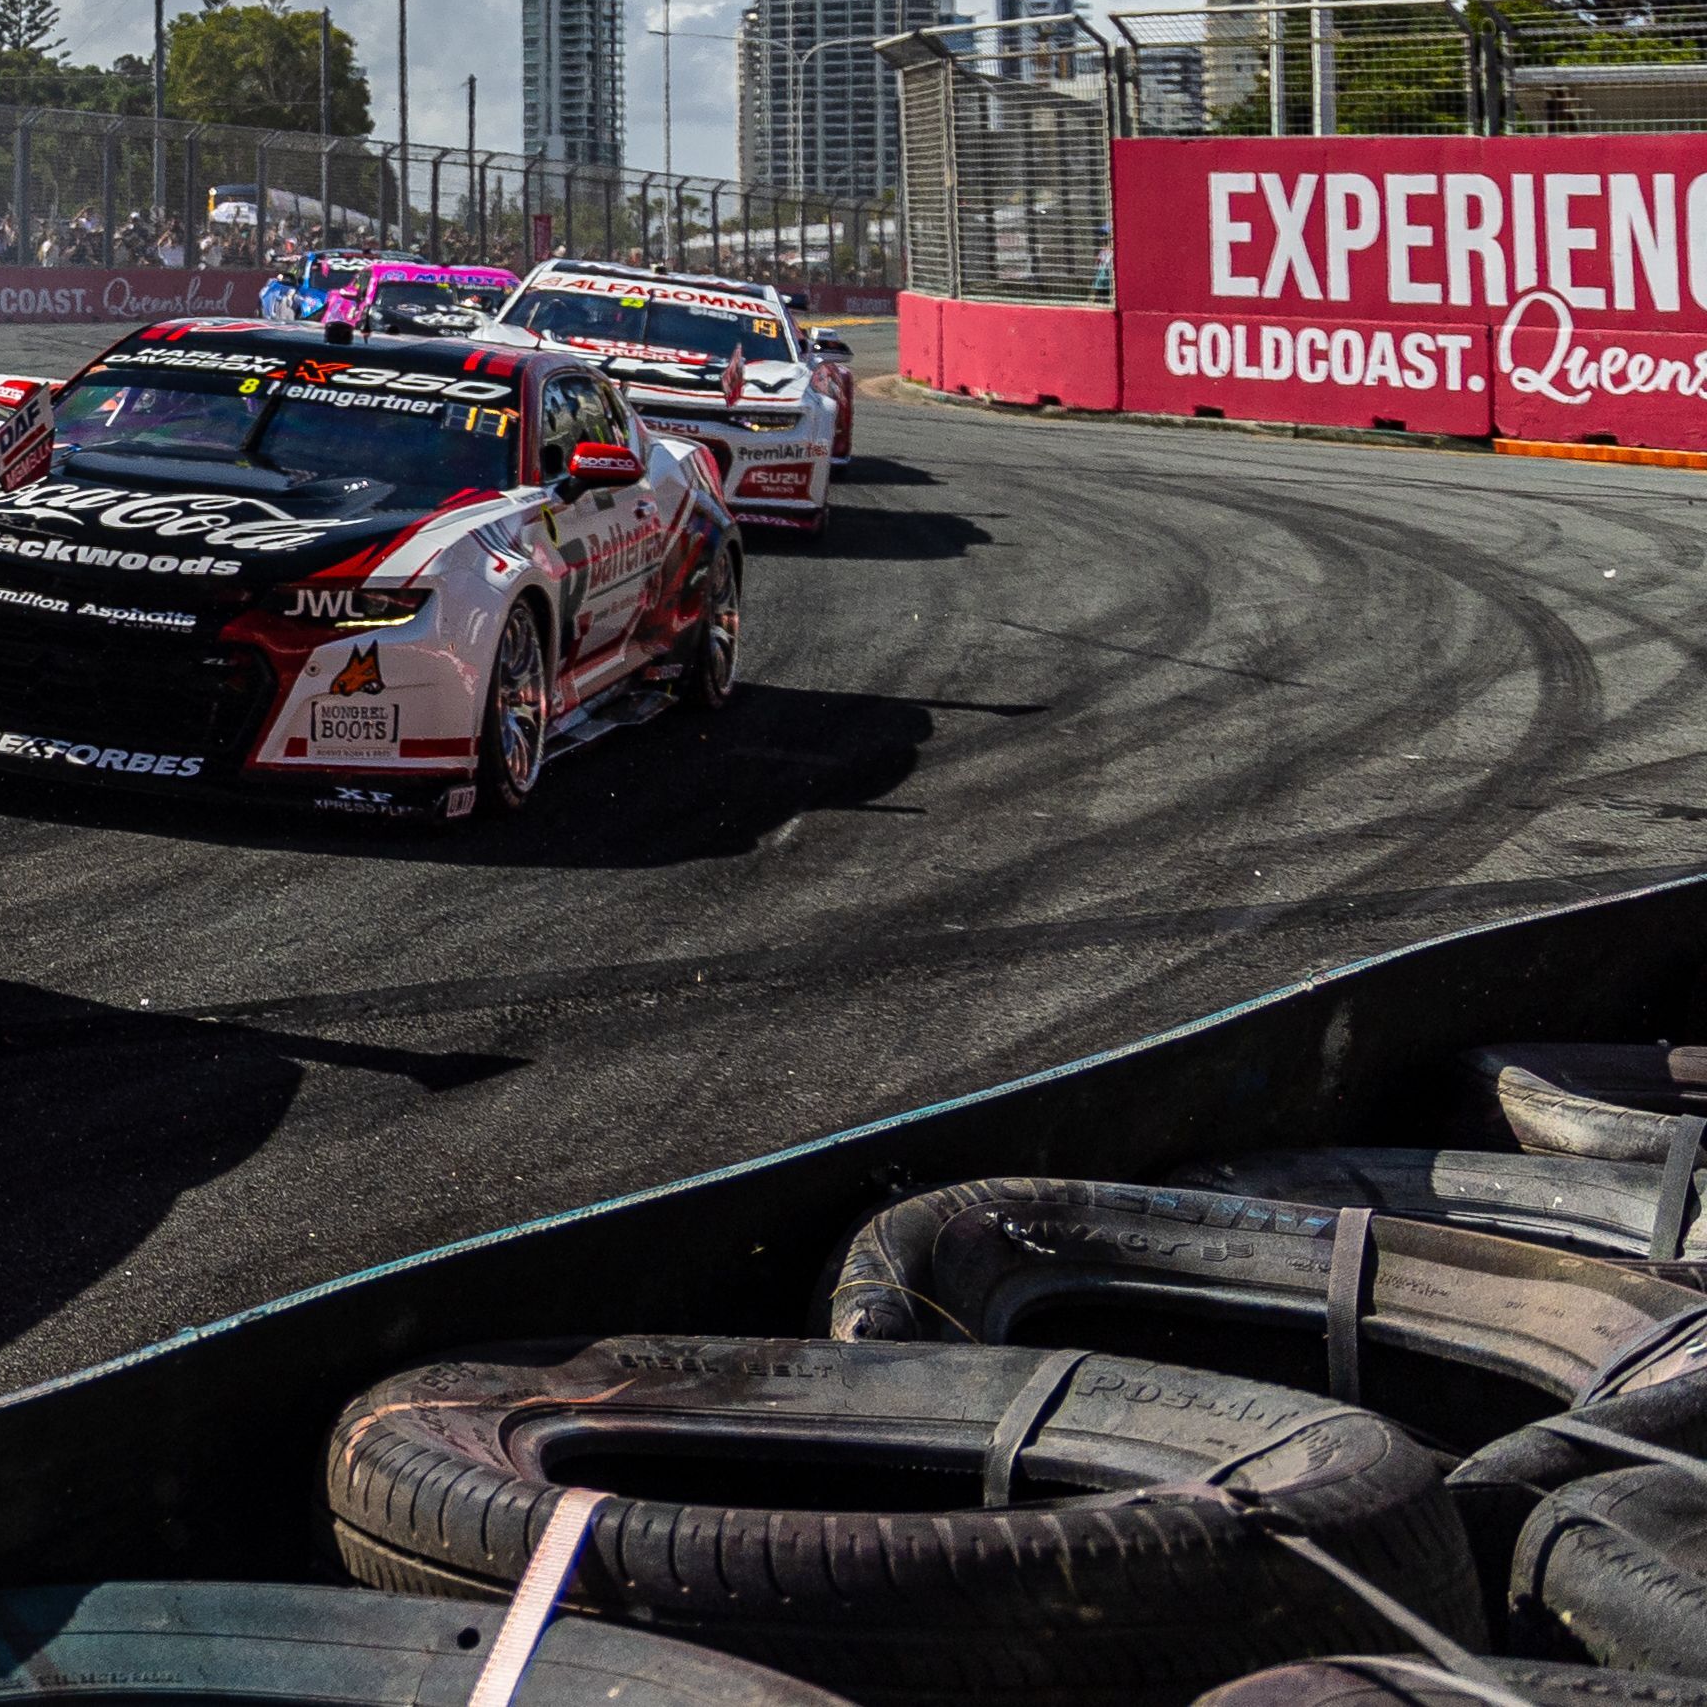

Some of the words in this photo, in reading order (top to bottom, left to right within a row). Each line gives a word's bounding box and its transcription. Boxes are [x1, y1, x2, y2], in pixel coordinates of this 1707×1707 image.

[102, 276, 234, 320] Queensland
[102, 353, 277, 375] DAVIDSON
[135, 347, 287, 368] HARLEY-
[1164, 319, 1486, 393] GOLDCOAST.
[238, 377, 261, 395] 8
[576, 455, 637, 470] sparco
[750, 471, 809, 485] ISUZU
[76, 602, 197, 626] Asphalts
[283, 589, 365, 618] JWL
[320, 705, 389, 720] MONGREL
[320, 720, 388, 740] BOOTS
